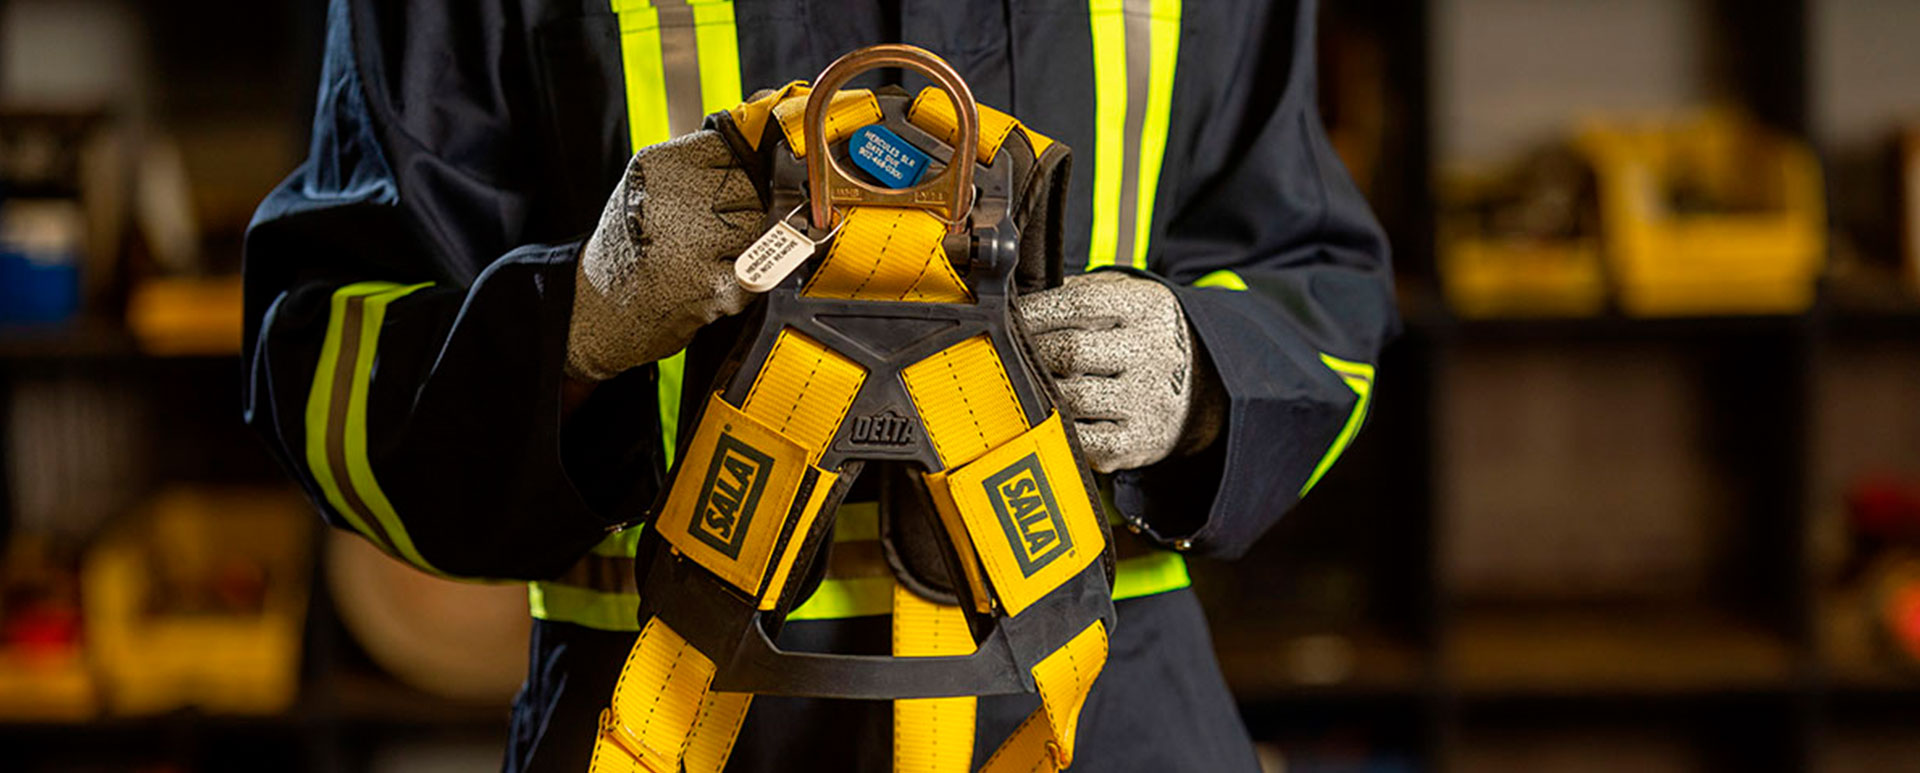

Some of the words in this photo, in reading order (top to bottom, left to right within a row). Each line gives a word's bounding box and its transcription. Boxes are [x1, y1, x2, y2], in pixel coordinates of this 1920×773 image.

[864, 130, 900, 158] HERCULES
[900, 153, 916, 167] SLR
[865, 142, 884, 158] DATE
[884, 152, 901, 168] DUE
[745, 247, 776, 274] HERCULES
[774, 236, 788, 249] SLR
[760, 260, 774, 273] NOT
[773, 240, 798, 262] REMOVE
[851, 412, 916, 444] DELTA
[705, 455, 755, 539] SALA
[1002, 477, 1057, 556] SALA
